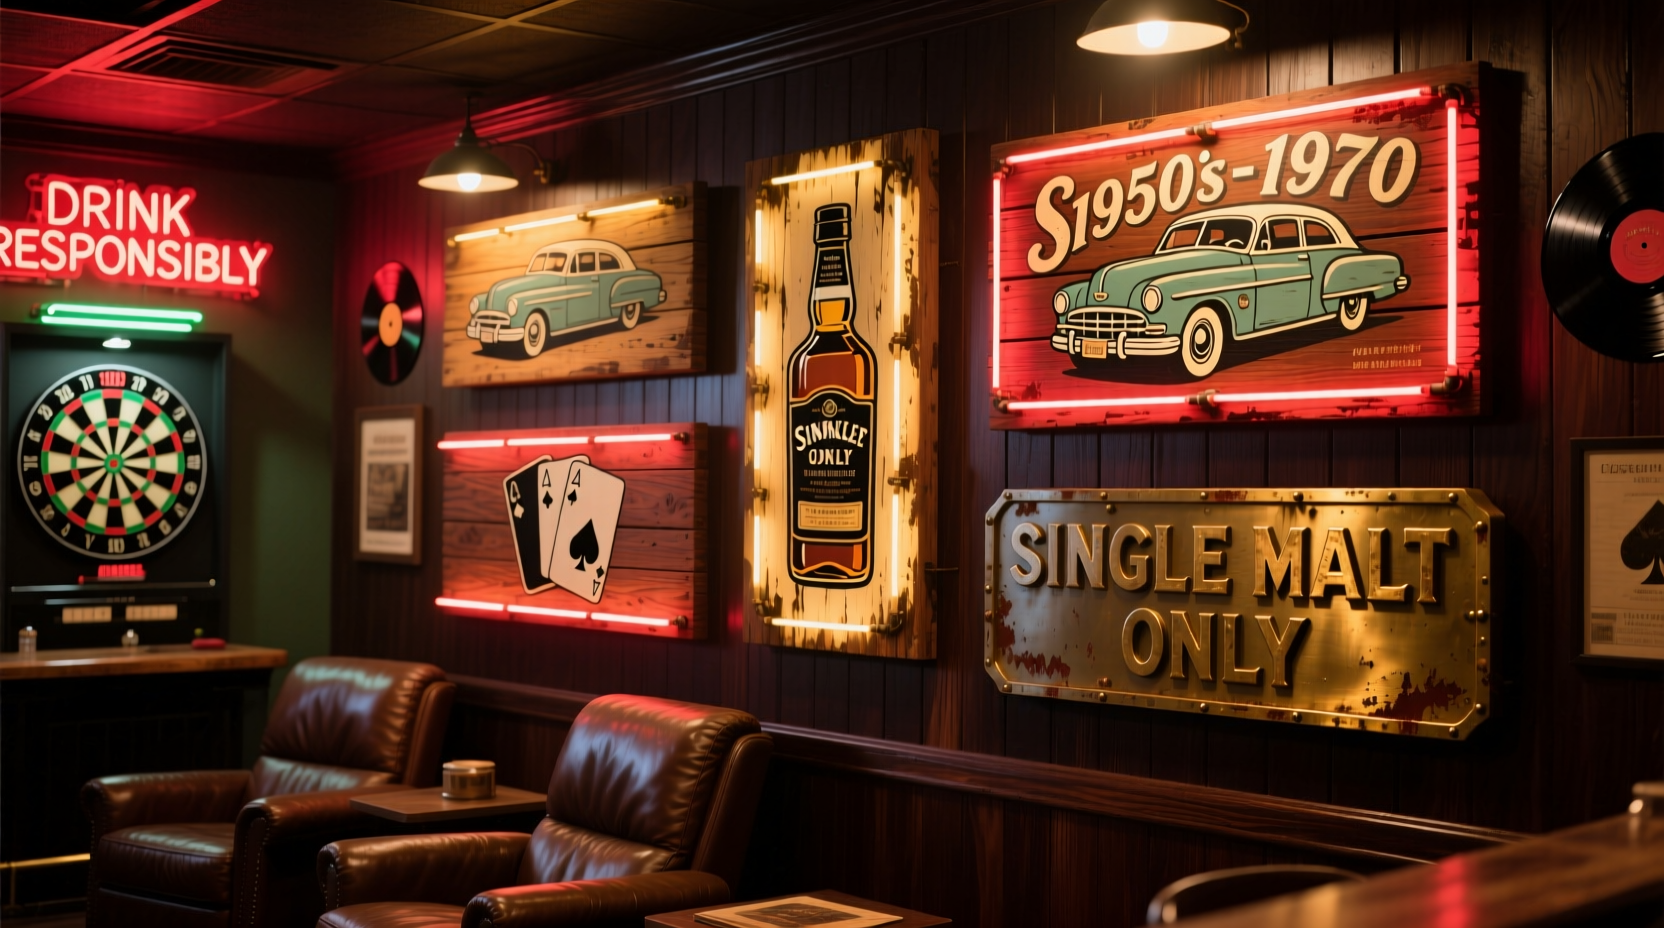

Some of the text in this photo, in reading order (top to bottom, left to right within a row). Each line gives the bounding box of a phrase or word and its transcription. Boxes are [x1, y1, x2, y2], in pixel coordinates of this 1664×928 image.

[47, 181, 191, 238] DRINK
[1009, 521, 1455, 606] SINGLE MALT
[1121, 606, 1311, 688] ONLY
